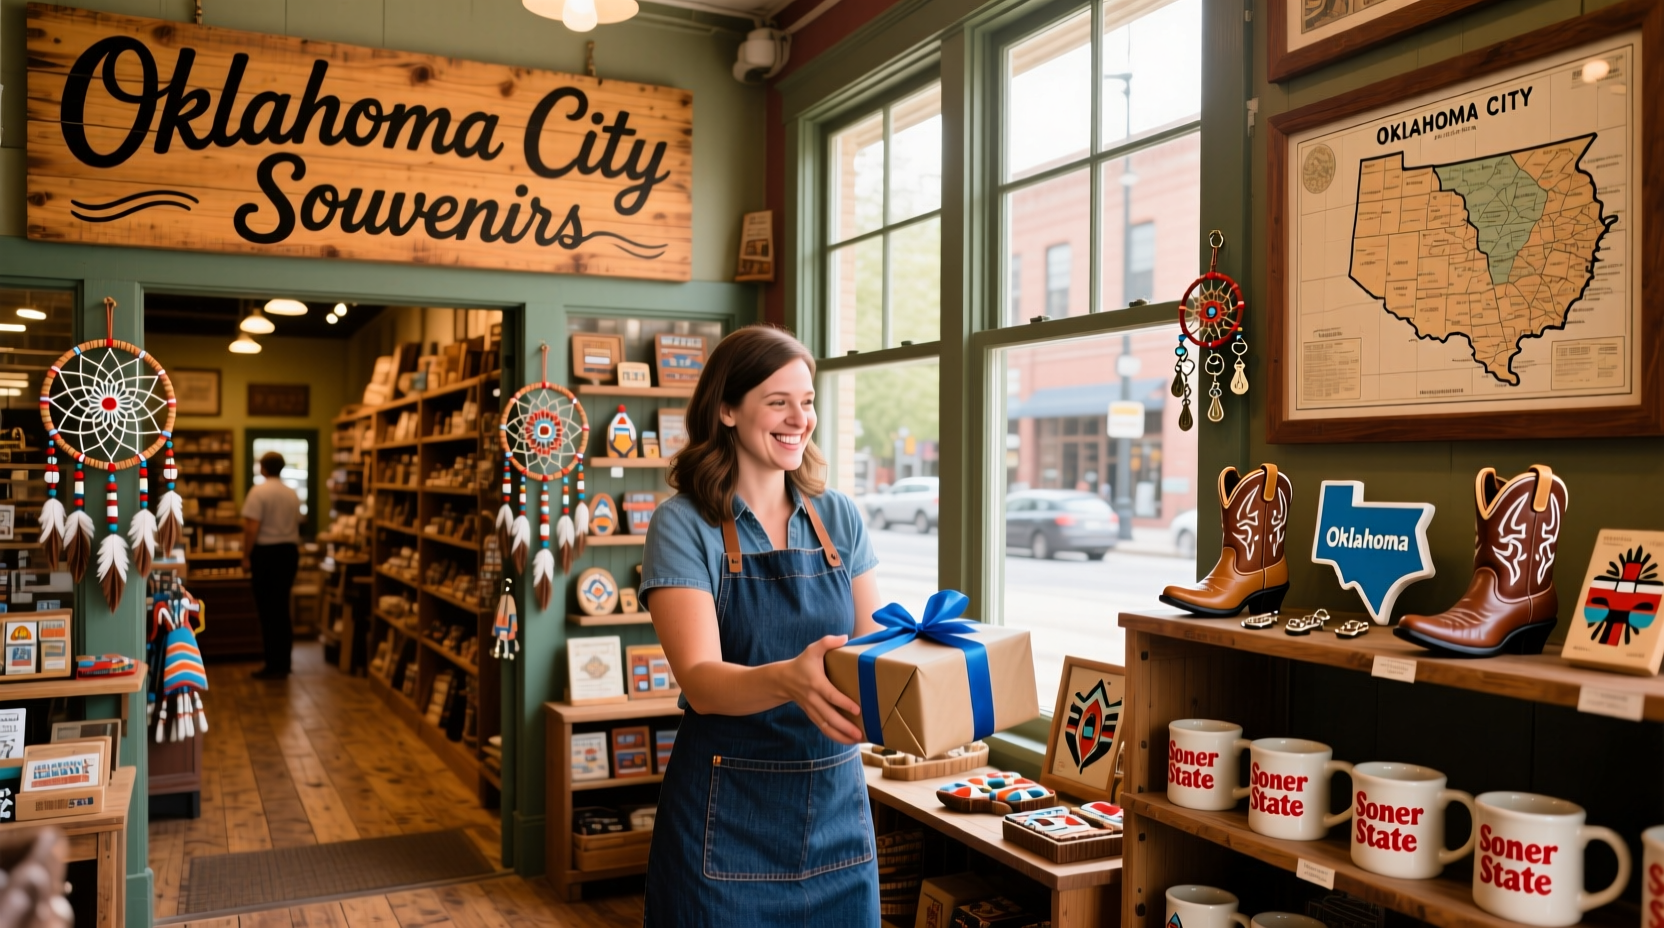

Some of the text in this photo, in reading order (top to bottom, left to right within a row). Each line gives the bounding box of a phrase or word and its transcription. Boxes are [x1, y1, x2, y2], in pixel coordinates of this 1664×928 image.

[60, 35, 671, 216] Oklahoma City
[1376, 102, 1479, 146] OKLAHOMA
[1486, 86, 1534, 117] CITY
[233, 152, 590, 250] Souvenirs
[1326, 526, 1410, 553] Oklahoma
[1169, 739, 1220, 768] Soner
[1168, 762, 1215, 790] State
[1250, 761, 1309, 793] Soner
[1250, 785, 1305, 818] State
[1355, 789, 1425, 827] Soner
[1355, 817, 1418, 853] State
[1479, 823, 1559, 866] Soner
[1479, 853, 1553, 897] State
